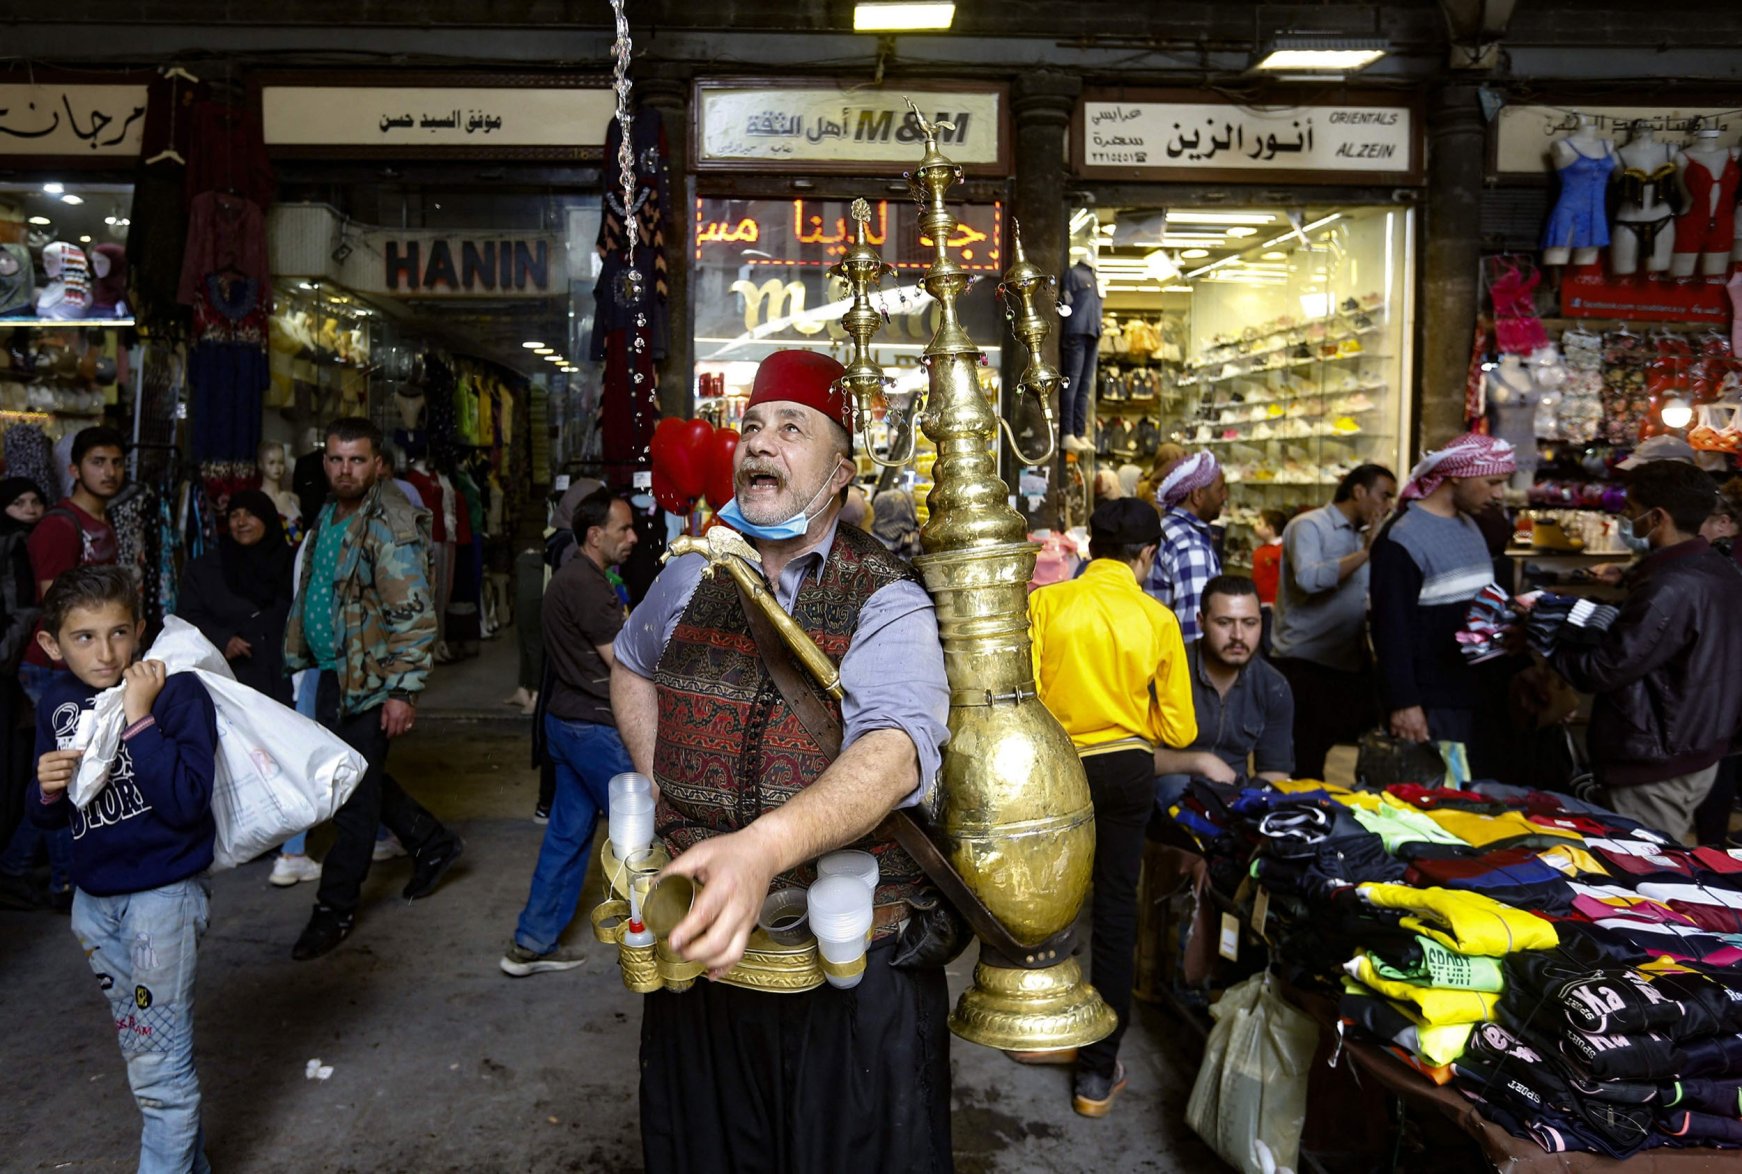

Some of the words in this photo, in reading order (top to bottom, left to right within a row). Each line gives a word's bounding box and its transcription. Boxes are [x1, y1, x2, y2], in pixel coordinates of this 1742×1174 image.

[379, 113, 415, 133] حسن
[420, 109, 461, 133] السيد
[465, 109, 502, 134] موفق
[746, 110, 801, 137] الثقة
[806, 107, 849, 143] أهل
[854, 109, 971, 144] M&M
[1328, 110, 1398, 126] ORIENTALS
[1166, 118, 1242, 160] الزين
[1246, 118, 1313, 160] أنور
[1335, 141, 1397, 159] ALZEIN
[385, 240, 549, 291] HANIN
[1507, 1079, 1541, 1104] SPORT
